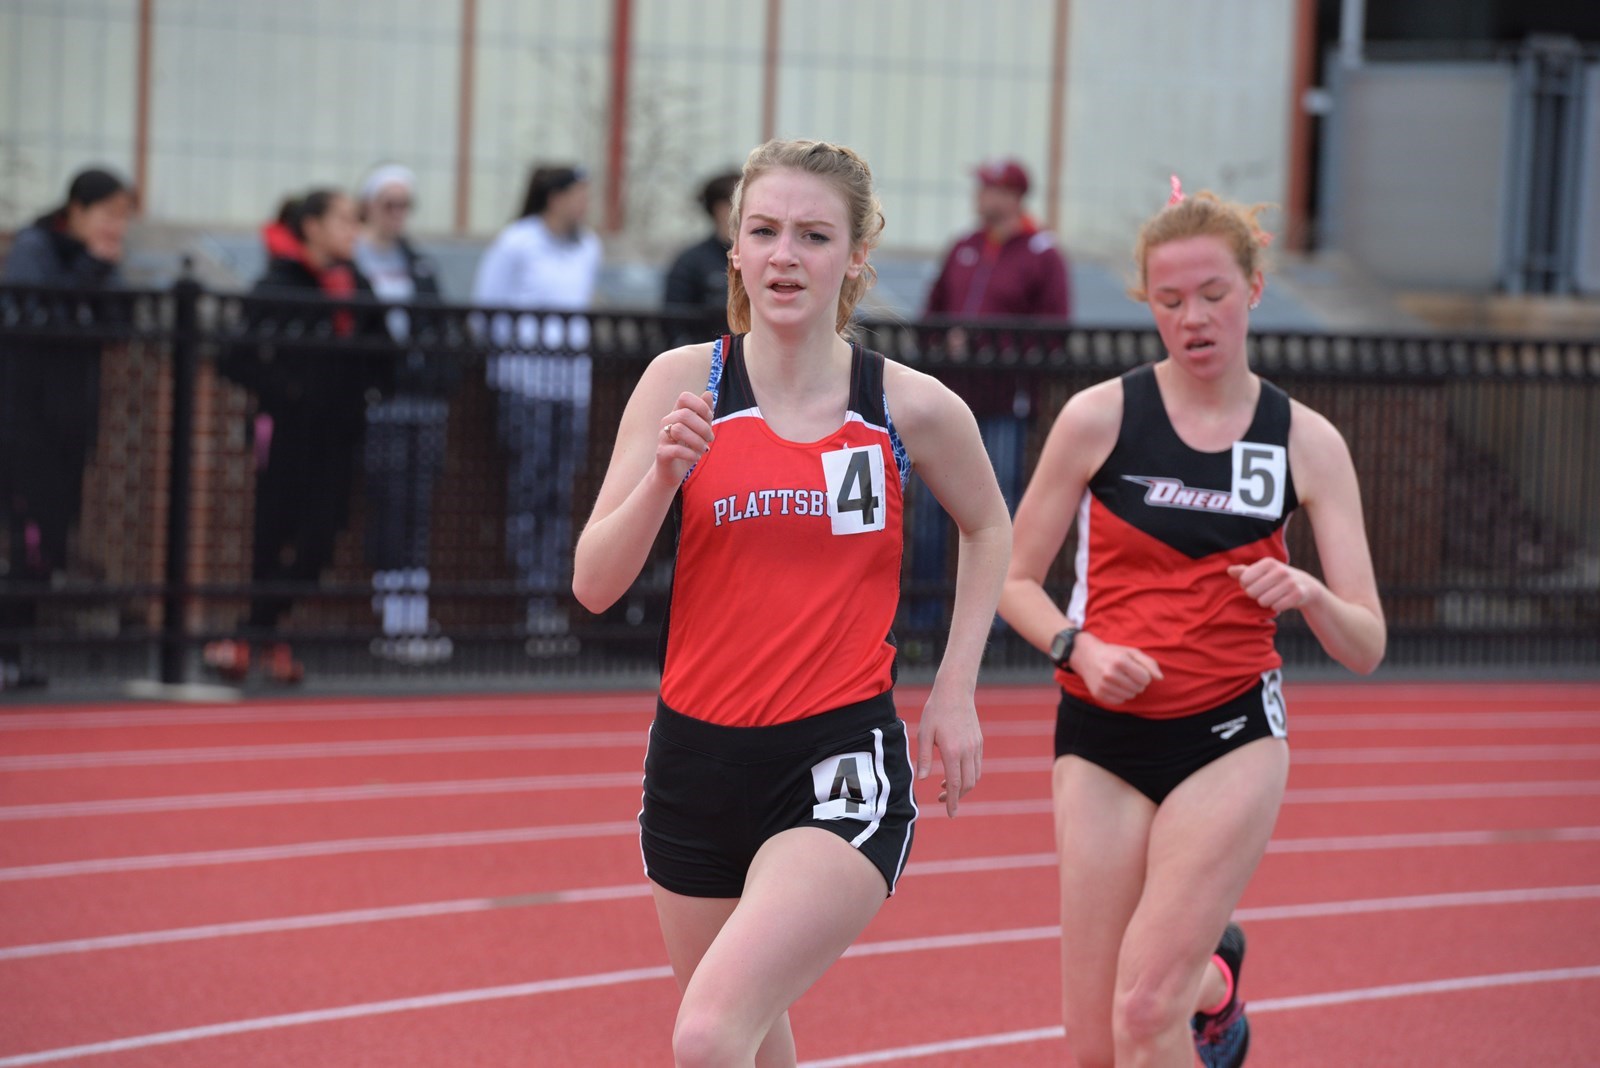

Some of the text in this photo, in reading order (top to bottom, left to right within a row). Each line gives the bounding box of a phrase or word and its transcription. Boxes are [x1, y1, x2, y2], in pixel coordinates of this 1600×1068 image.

[713, 489, 832, 527] PLATTSB
[837, 451, 879, 525] 4
[1239, 448, 1275, 508] 5
[1267, 671, 1286, 732] 5
[828, 757, 867, 813] 4
